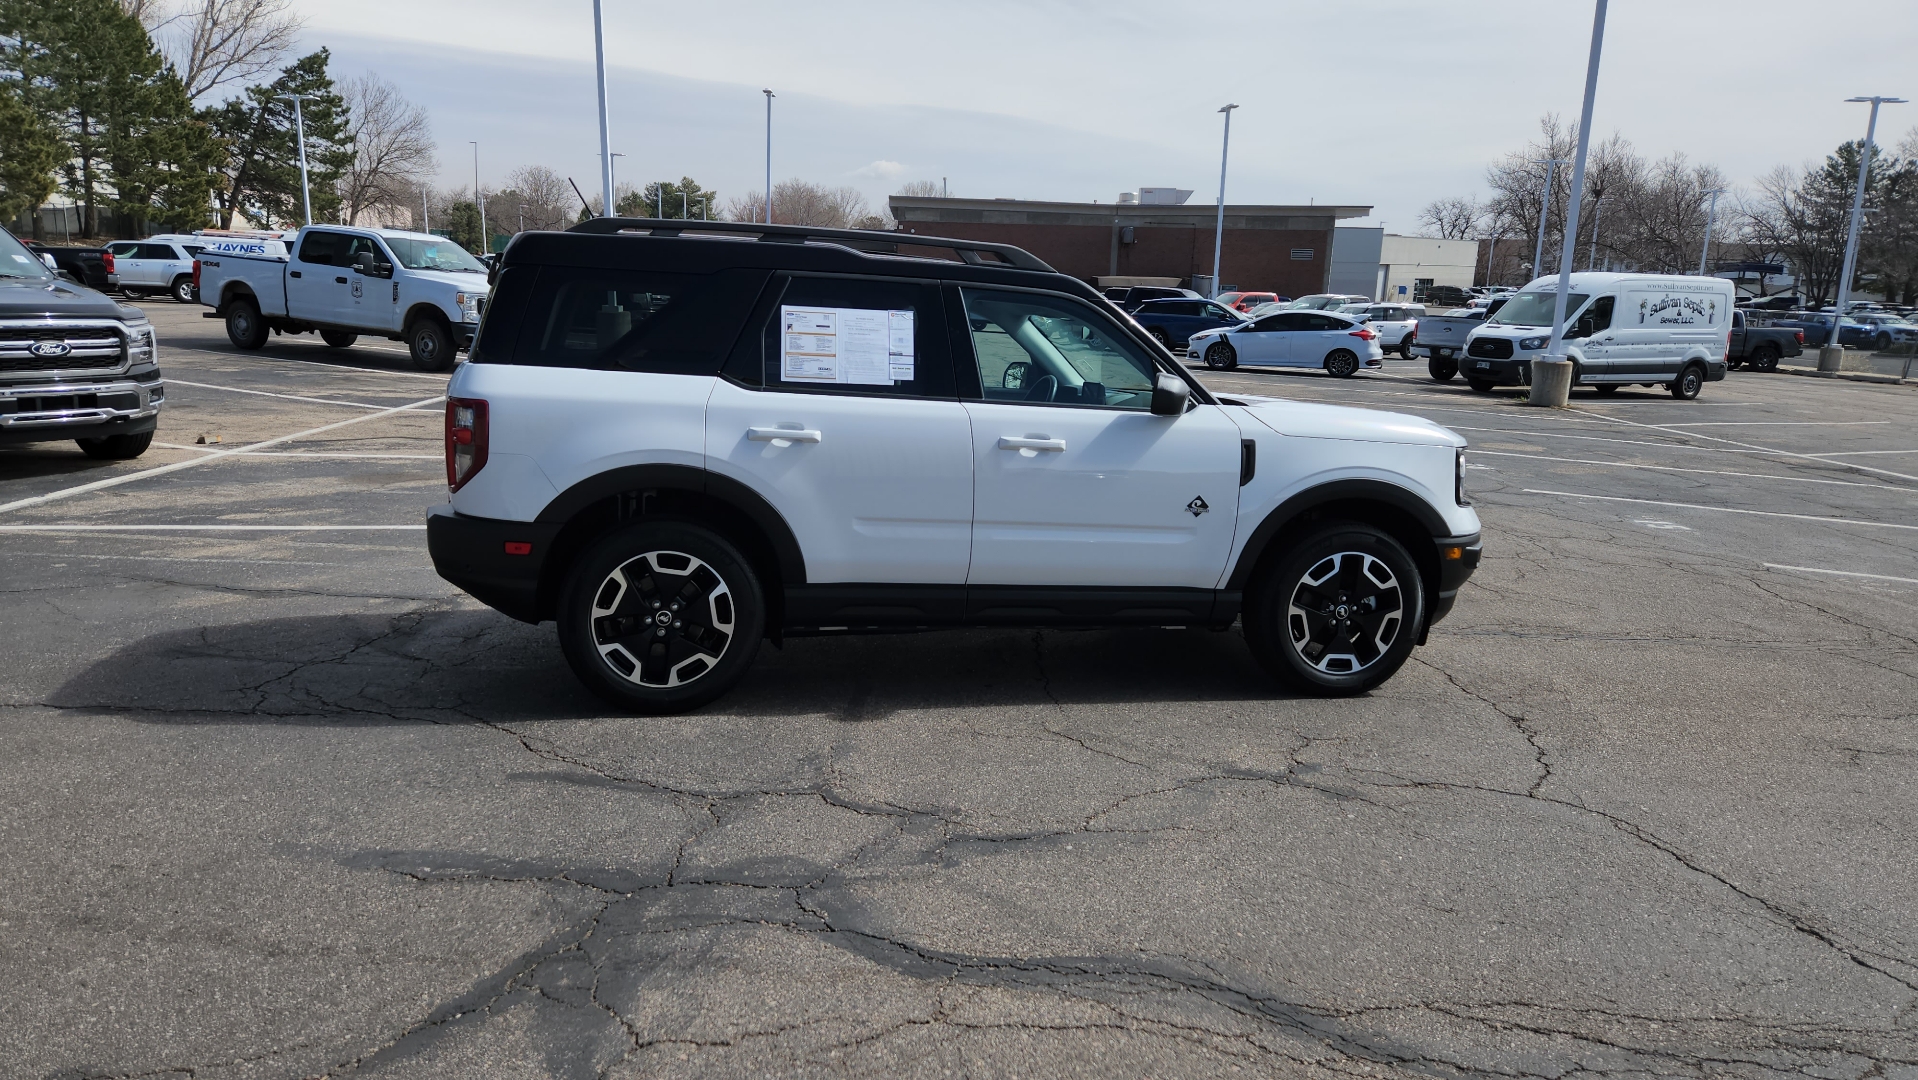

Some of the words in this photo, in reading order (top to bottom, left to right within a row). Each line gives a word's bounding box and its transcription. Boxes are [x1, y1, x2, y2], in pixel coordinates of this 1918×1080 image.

[213, 242, 265, 254] HAYNES
[1650, 297, 1681, 317] Sullivan
[1684, 297, 1705, 317] Septic
[38, 343, 64, 354] Ford
